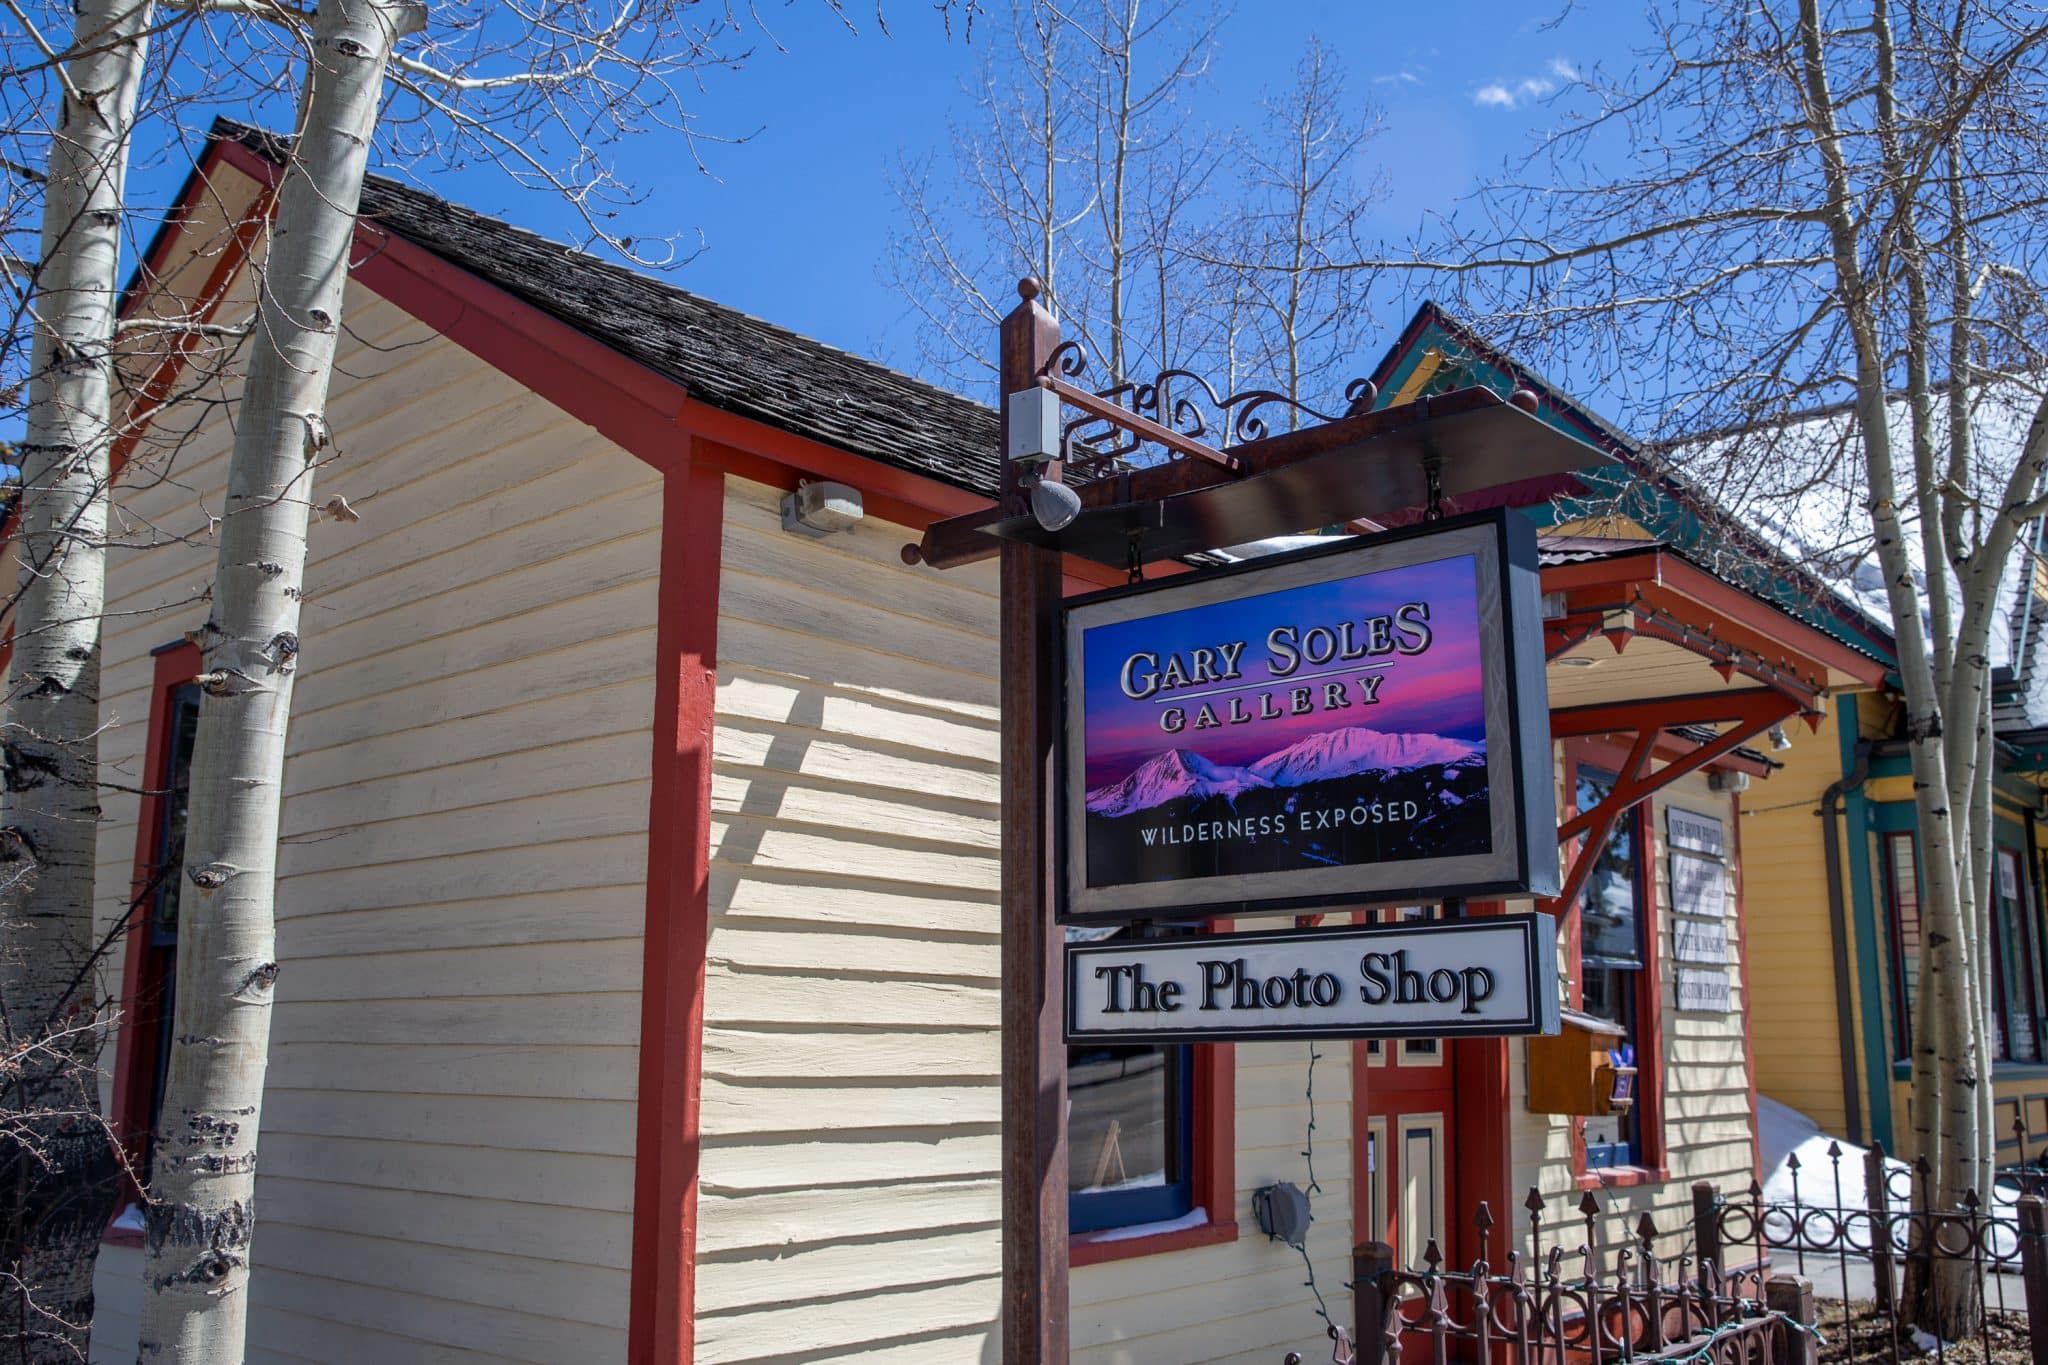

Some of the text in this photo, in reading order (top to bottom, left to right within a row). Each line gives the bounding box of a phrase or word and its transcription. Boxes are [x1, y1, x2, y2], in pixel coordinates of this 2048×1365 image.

[1120, 602, 1432, 700] GARY SOLES
[1159, 675, 1385, 733] GALLERY
[1141, 800, 1418, 847] WILDERNESS EXPOSED
[1094, 949, 1495, 1014] The Photo Shop
